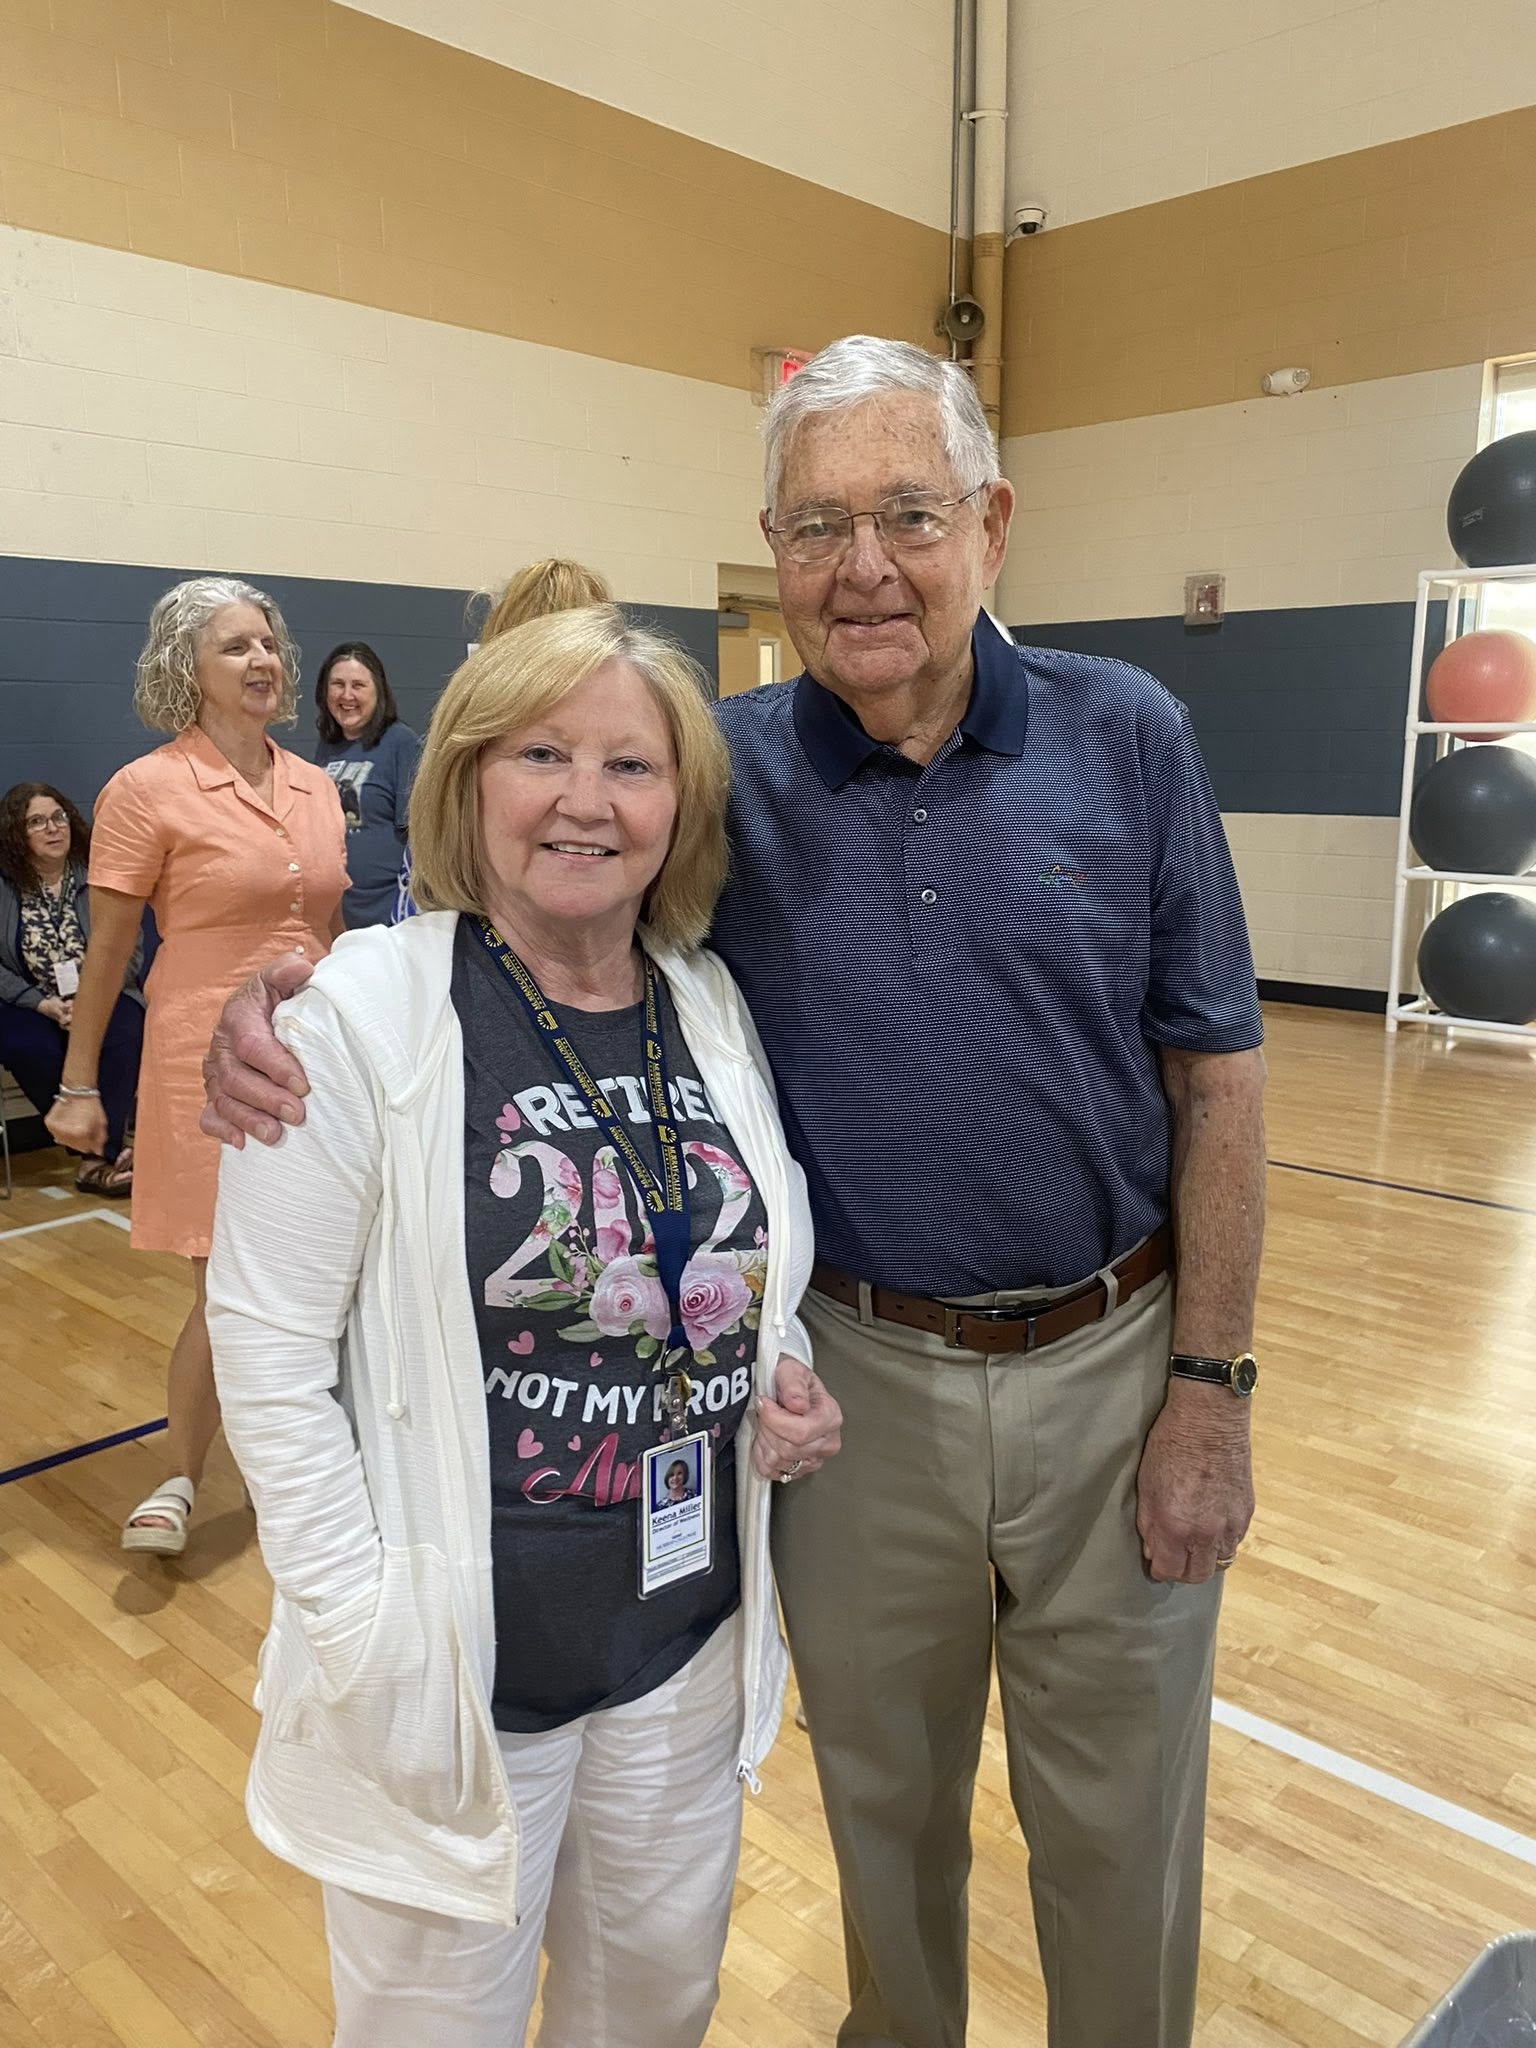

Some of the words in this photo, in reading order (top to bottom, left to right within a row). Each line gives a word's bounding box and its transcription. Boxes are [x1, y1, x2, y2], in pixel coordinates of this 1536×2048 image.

[485, 1366, 579, 1418] NOT
[581, 1383, 647, 1424] MY
[653, 1362, 757, 1422] ROB
[521, 1432, 641, 1507] An
[679, 1502, 702, 1515] Miller
